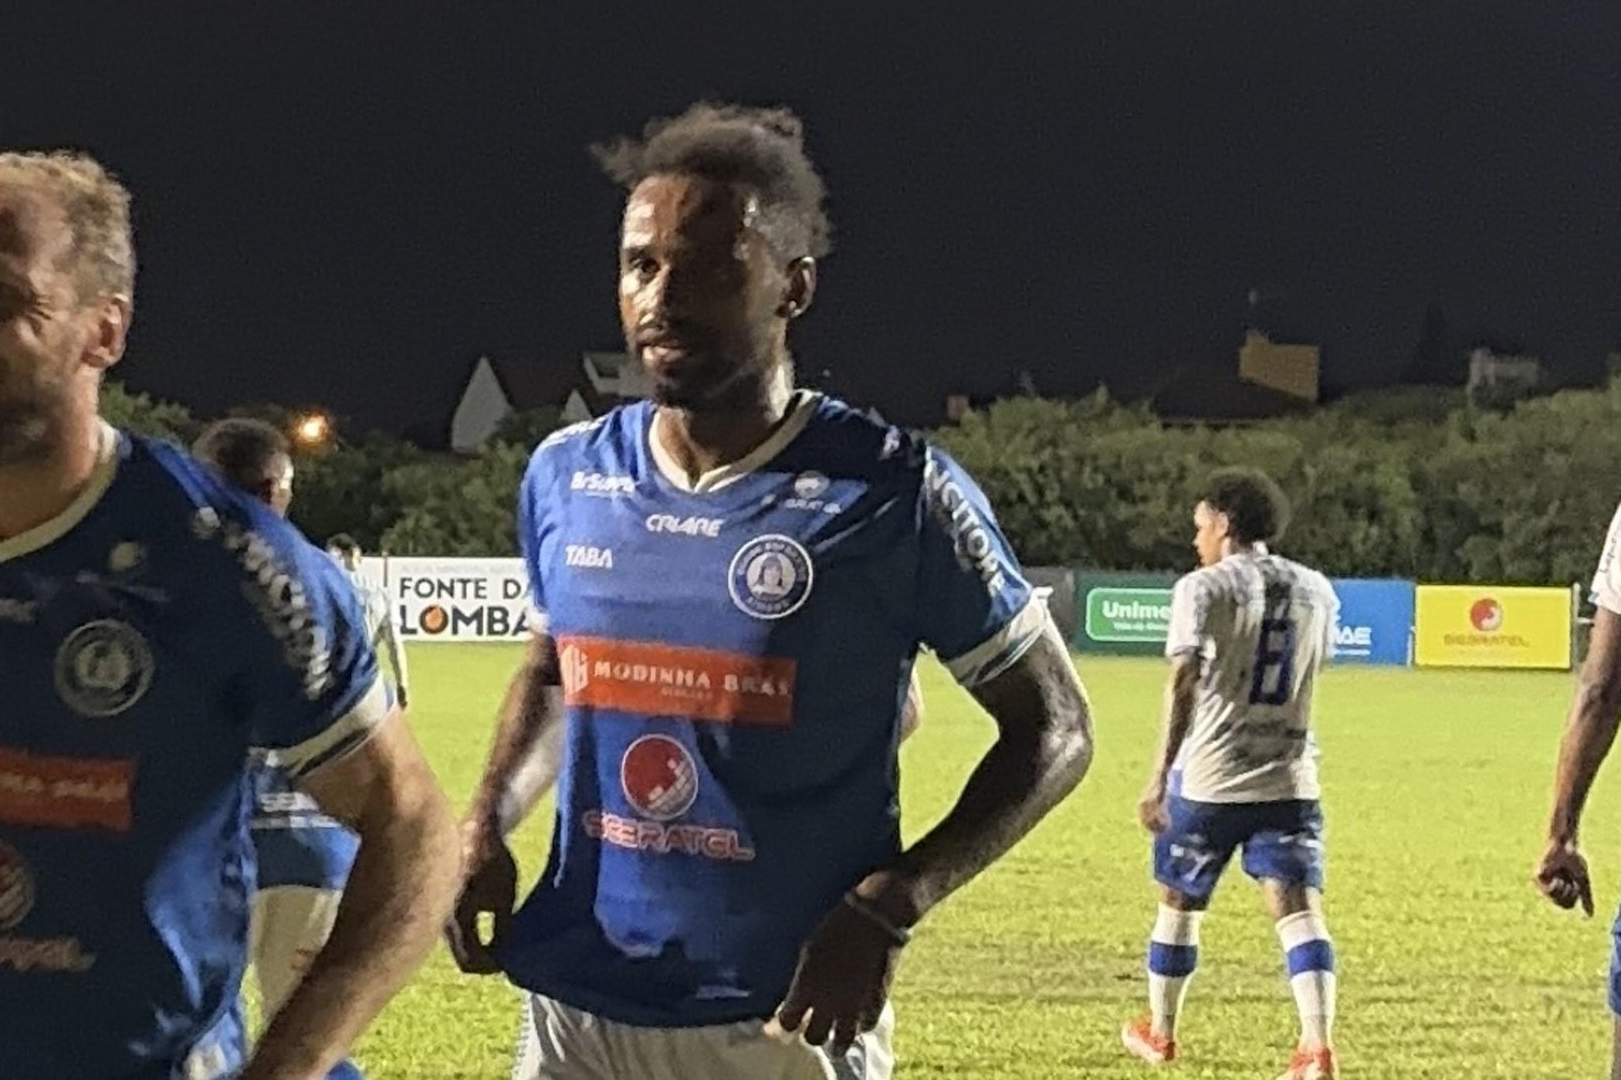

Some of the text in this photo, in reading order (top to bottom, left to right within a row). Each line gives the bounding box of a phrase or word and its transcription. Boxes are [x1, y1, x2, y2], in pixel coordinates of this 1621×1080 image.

[399, 577, 488, 599] FONTE
[1102, 601, 1172, 620] Unime
[1248, 618, 1295, 705] 8
[594, 660, 712, 690] MODINHA
